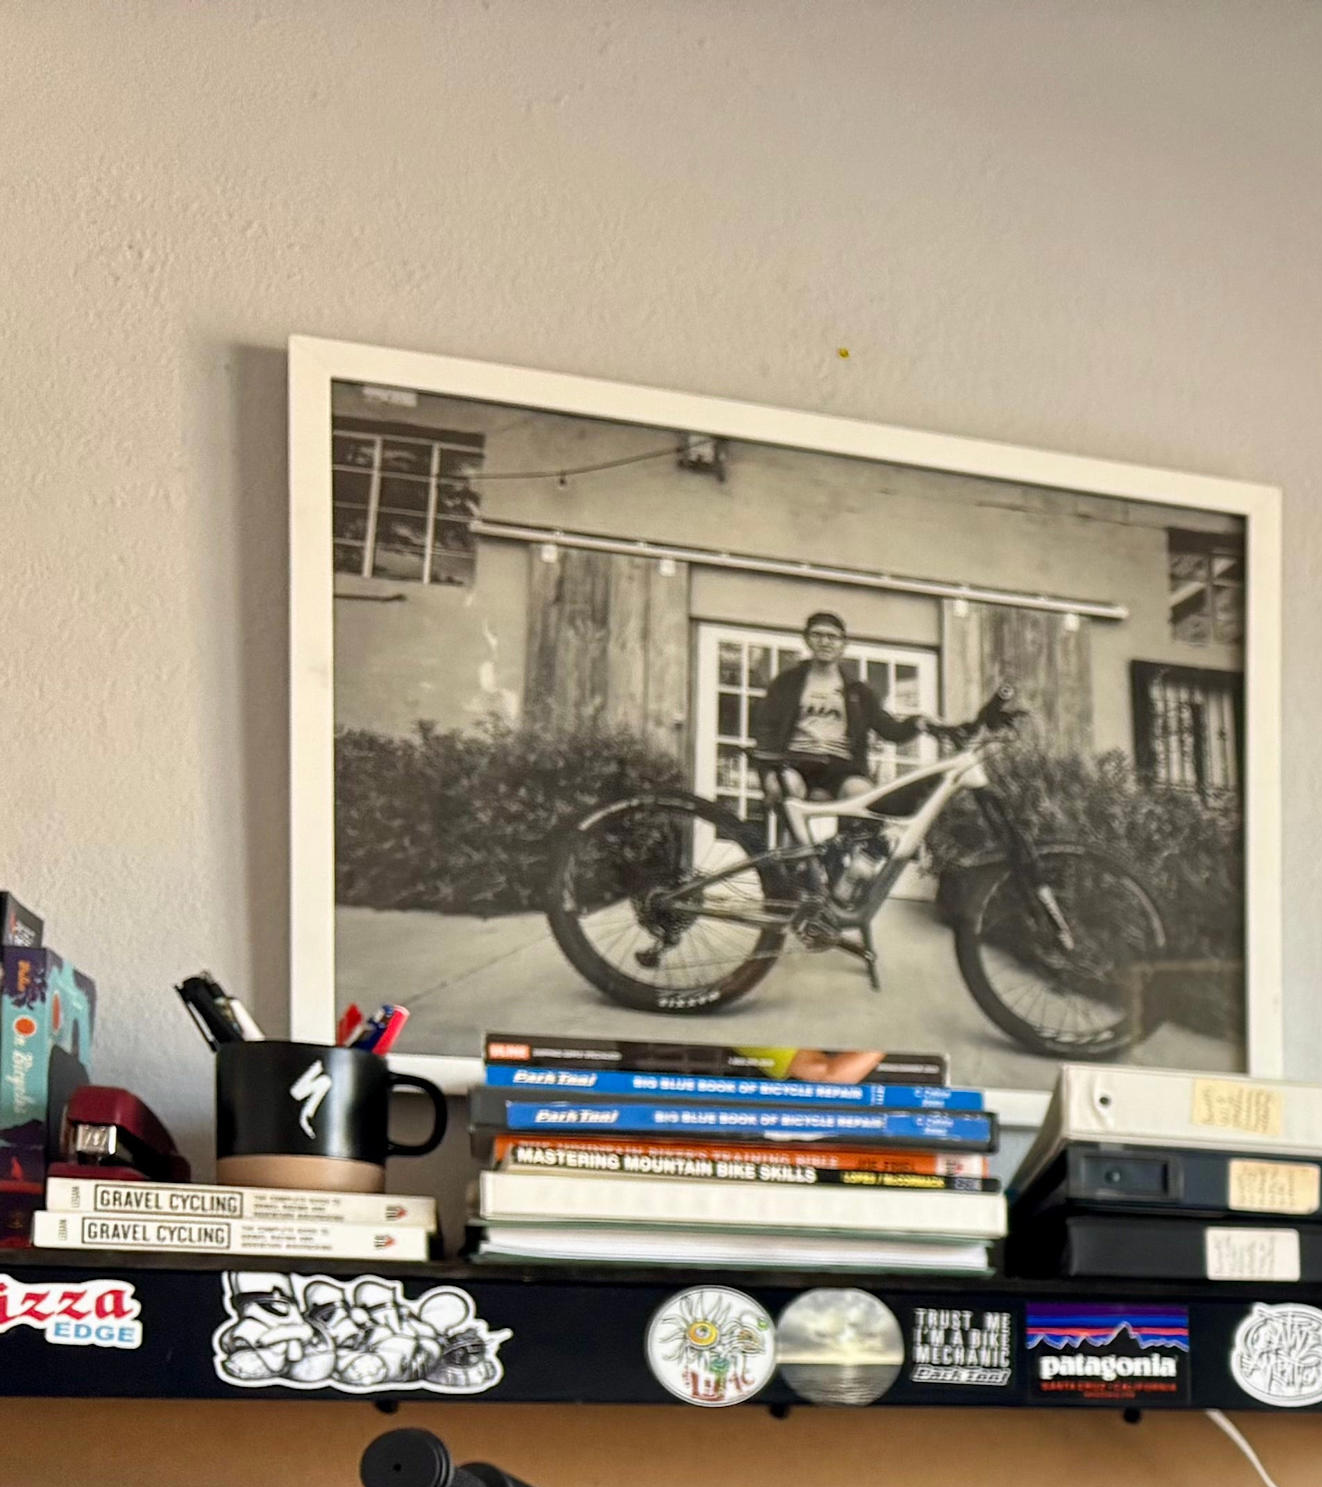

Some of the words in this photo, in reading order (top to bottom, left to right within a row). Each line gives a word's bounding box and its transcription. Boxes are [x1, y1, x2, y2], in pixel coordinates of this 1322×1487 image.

[633, 1076, 658, 1090] BIG
[660, 1077, 695, 1091] BLUE
[696, 1079, 736, 1093] BOOK
[739, 1081, 757, 1095] OF
[759, 1084, 814, 1098] BICYCLE
[816, 1086, 864, 1100] REPAIR
[654, 1110, 679, 1124] BIG
[681, 1111, 717, 1125] BLUE
[719, 1112, 758, 1126] BOOK
[760, 1114, 778, 1126] OF
[781, 1115, 835, 1128] BICYCLE
[837, 1117, 885, 1130] REPAIR
[517, 1148, 621, 1170] MASTERING
[624, 1155, 713, 1177] MOUNTAIN
[716, 1162, 757, 1181] BIKE
[758, 1164, 818, 1185] SKILLS
[100, 1189, 160, 1211] GRAVEL
[169, 1193, 239, 1214] CYCLING
[87, 1221, 150, 1242] GRAVEL
[156, 1224, 226, 1245] CYCLING
[54, 1321, 137, 1343] EDGE
[915, 1308, 974, 1329] TRUST
[983, 1311, 1011, 1332] ME
[914, 1328, 945, 1347] I'M
[953, 1330, 966, 1348] A
[970, 1329, 1011, 1350] BIKE
[914, 1346, 1011, 1368] MECHANIC
[1039, 1353, 1177, 1381] patagonia
